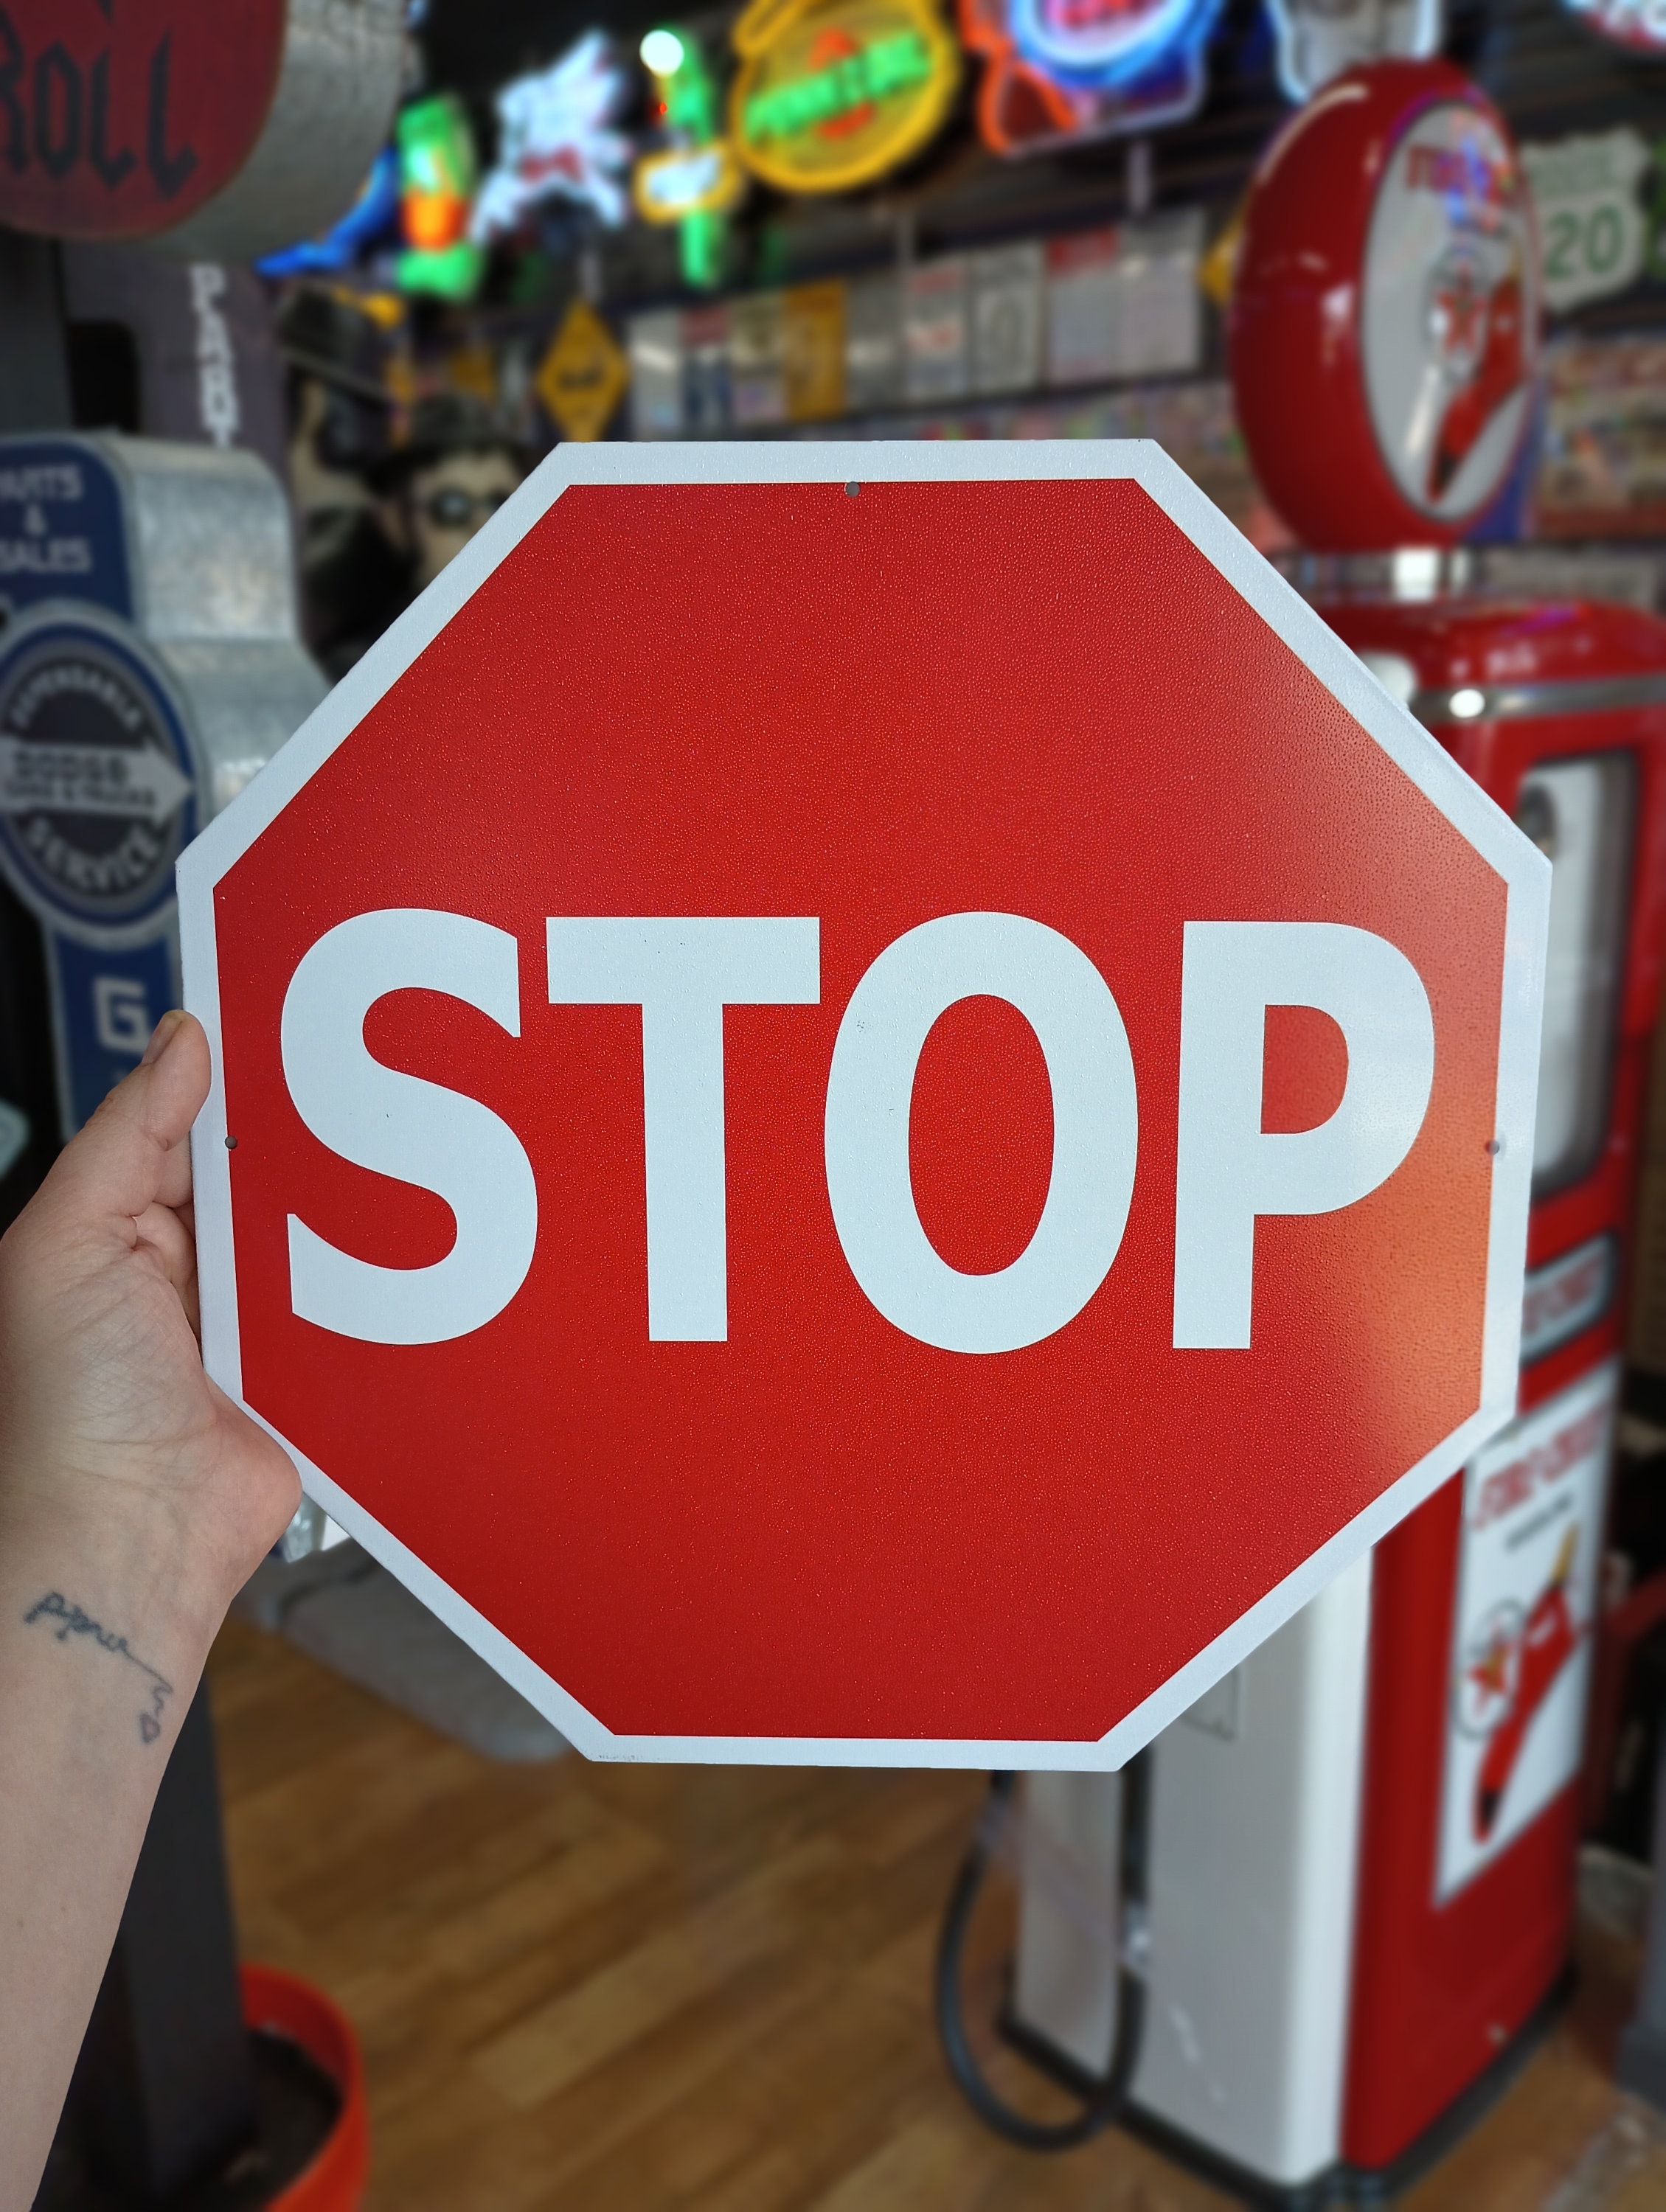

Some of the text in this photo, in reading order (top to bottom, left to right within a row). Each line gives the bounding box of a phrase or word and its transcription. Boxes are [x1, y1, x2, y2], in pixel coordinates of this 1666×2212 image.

[1546, 205, 1624, 277] 20
[29, 815, 162, 891] SERVICE
[281, 908, 1435, 1354] STOP
